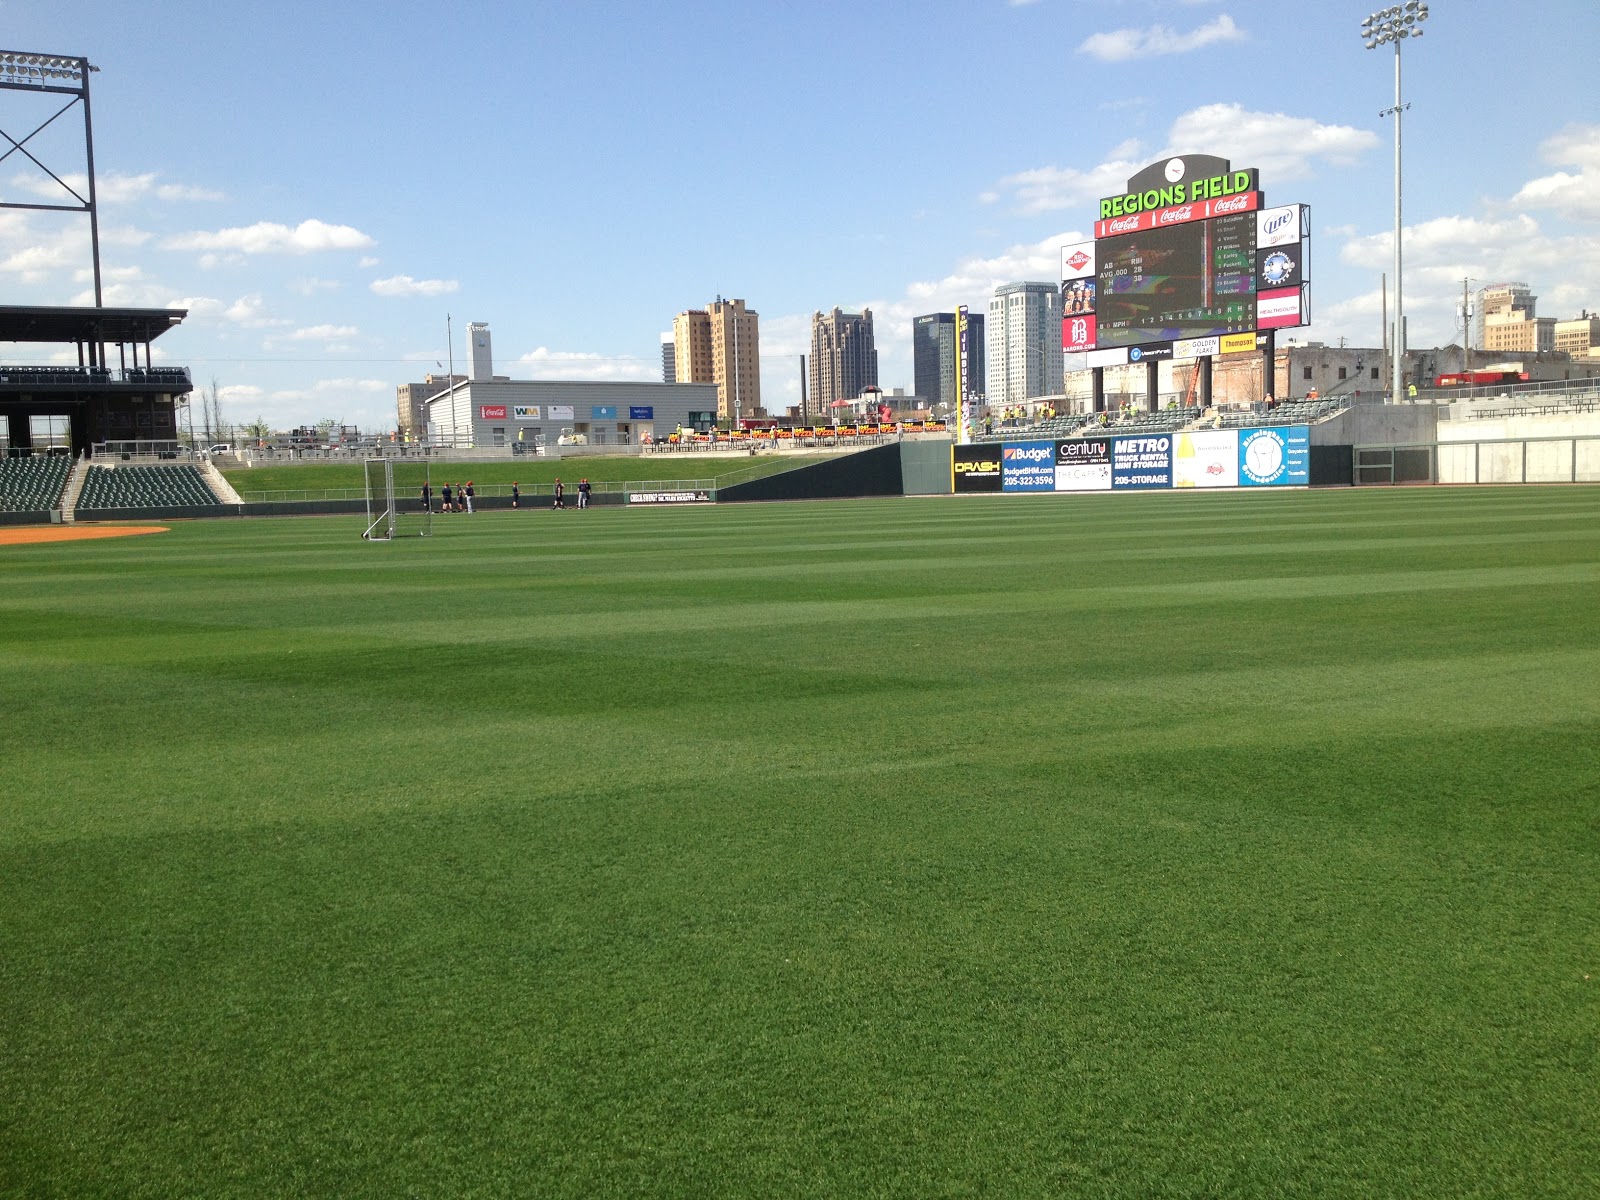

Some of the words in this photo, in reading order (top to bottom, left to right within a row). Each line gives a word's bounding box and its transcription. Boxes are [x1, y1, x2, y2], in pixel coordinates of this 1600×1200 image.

[1100, 184, 1186, 219] REGIONS
[1191, 171, 1250, 201] FIELD
[1214, 195, 1249, 213] Coca-Cola
[1160, 206, 1193, 224] Coca-Cola
[1109, 216, 1140, 232] Coca-Cola
[1100, 271, 1113, 279] AVG
[1192, 339, 1217, 348] GOLDEN
[1225, 338, 1253, 348] Thompson
[1196, 346, 1213, 354] FLAKE
[515, 407, 539, 415] WM
[1242, 429, 1285, 447] Birmingham
[1061, 441, 1106, 457] century
[1114, 438, 1169, 453] METRO
[1017, 447, 1051, 461] Budget
[1114, 454, 1139, 462] TRUCK
[1140, 453, 1169, 461] RENTAL
[955, 461, 1001, 472] DRASH
[1133, 460, 1169, 469] STORAGE
[1004, 467, 1054, 476] BudgetBHM.com
[1004, 476, 1054, 485] 205-322-3596
[1114, 475, 1169, 484] 205-STORAGE
